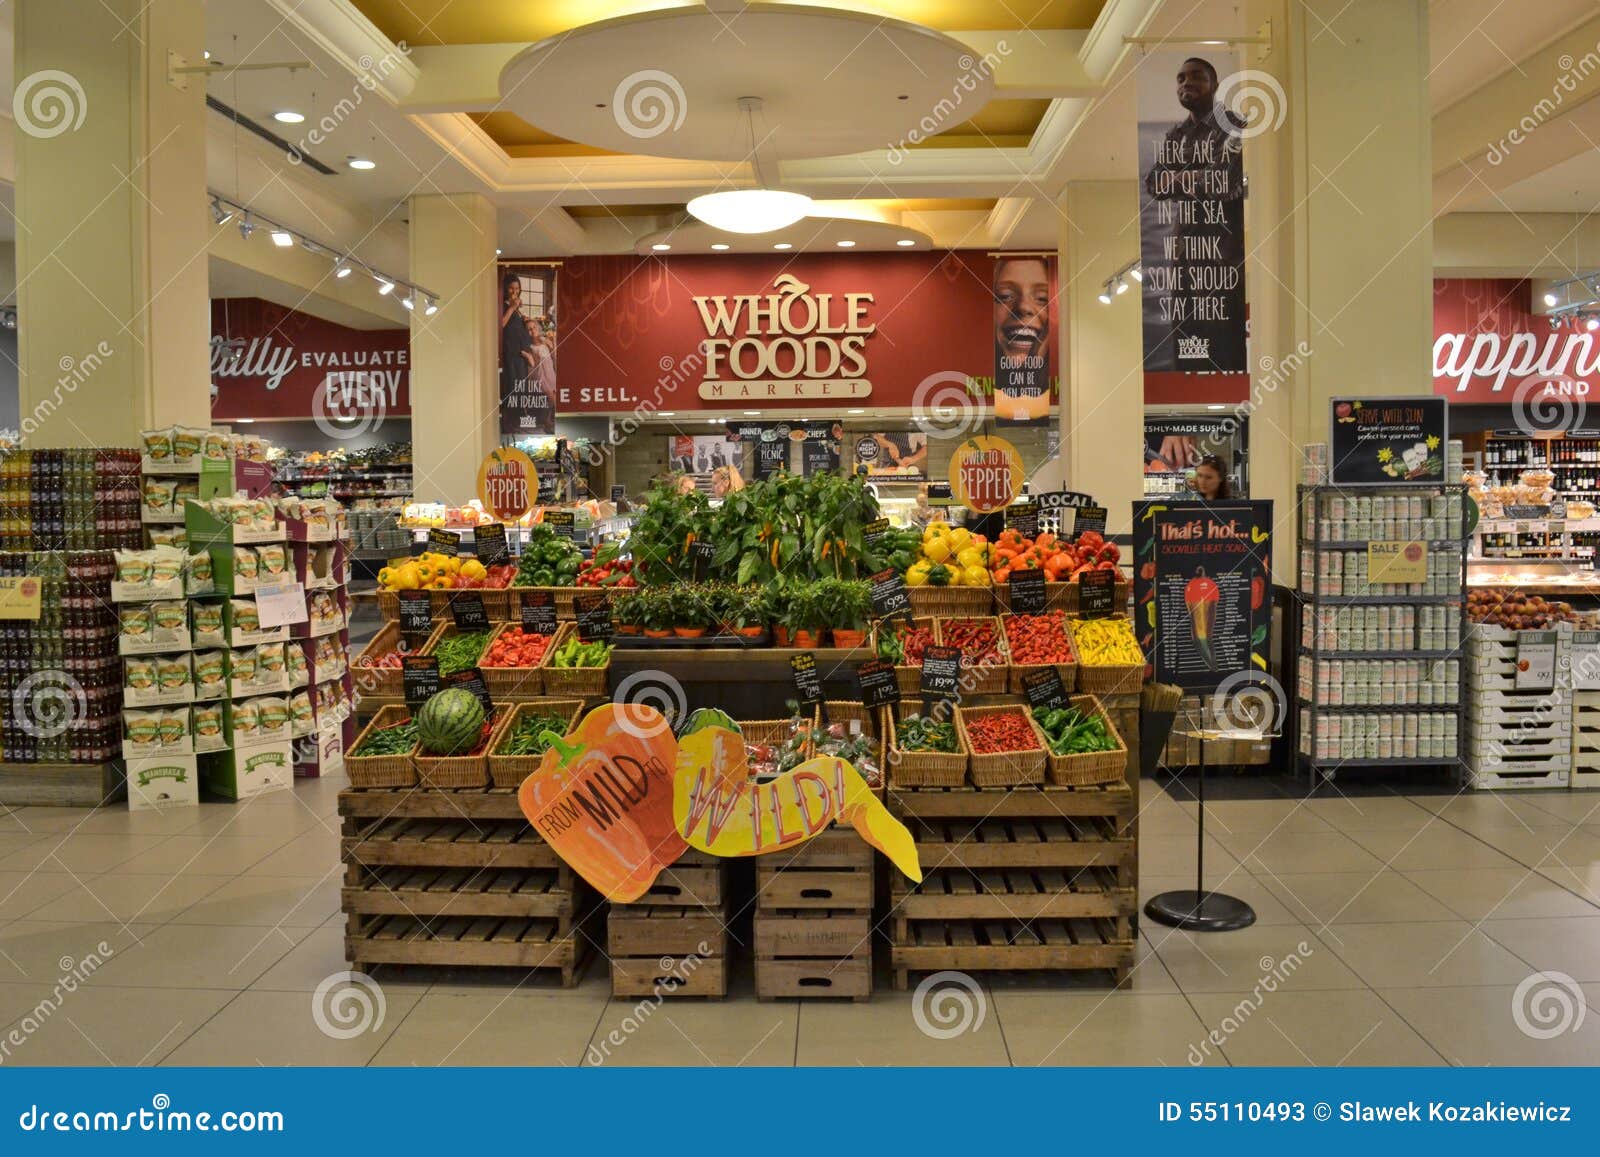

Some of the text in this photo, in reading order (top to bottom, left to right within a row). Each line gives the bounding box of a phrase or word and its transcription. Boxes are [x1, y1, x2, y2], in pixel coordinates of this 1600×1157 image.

[1152, 140, 1231, 164] THERE ARE A
[1155, 170, 1229, 194] LOT OF FISH
[1158, 199, 1228, 225] IN THE SEA.
[1163, 235, 1224, 260] WE THINK
[1148, 265, 1239, 291] SOME SHOULD
[692, 284, 876, 337] WHOLE
[1160, 296, 1230, 321] STAY THERE.
[1178, 337, 1210, 347] WHOLE
[1179, 346, 1209, 356] FOODS
[302, 350, 407, 367] EVALUATE
[703, 336, 868, 380] FOODS
[1000, 356, 1044, 370] GOOD FOOD
[1432, 331, 1600, 393] appin
[514, 379, 542, 392] EAT LIKE
[966, 376, 995, 396] KEN
[1009, 372, 1035, 385] CAN BE
[1543, 380, 1589, 396] AND
[326, 370, 401, 408] EVERY
[560, 387, 638, 403] E SELL.
[712, 383, 859, 396] MARKET
[507, 396, 518, 408] AN
[509, 461, 516, 475] TO
[959, 450, 1014, 466] POWER TO THE
[959, 467, 1014, 500] PEPPER
[485, 478, 529, 510] PEPPER
[1041, 494, 1088, 508] LOCAL
[1160, 520, 1203, 541] That's
[1372, 544, 1399, 554] SALE
[538, 755, 668, 840] FROM MILD TO
[684, 760, 846, 851] WILD!
